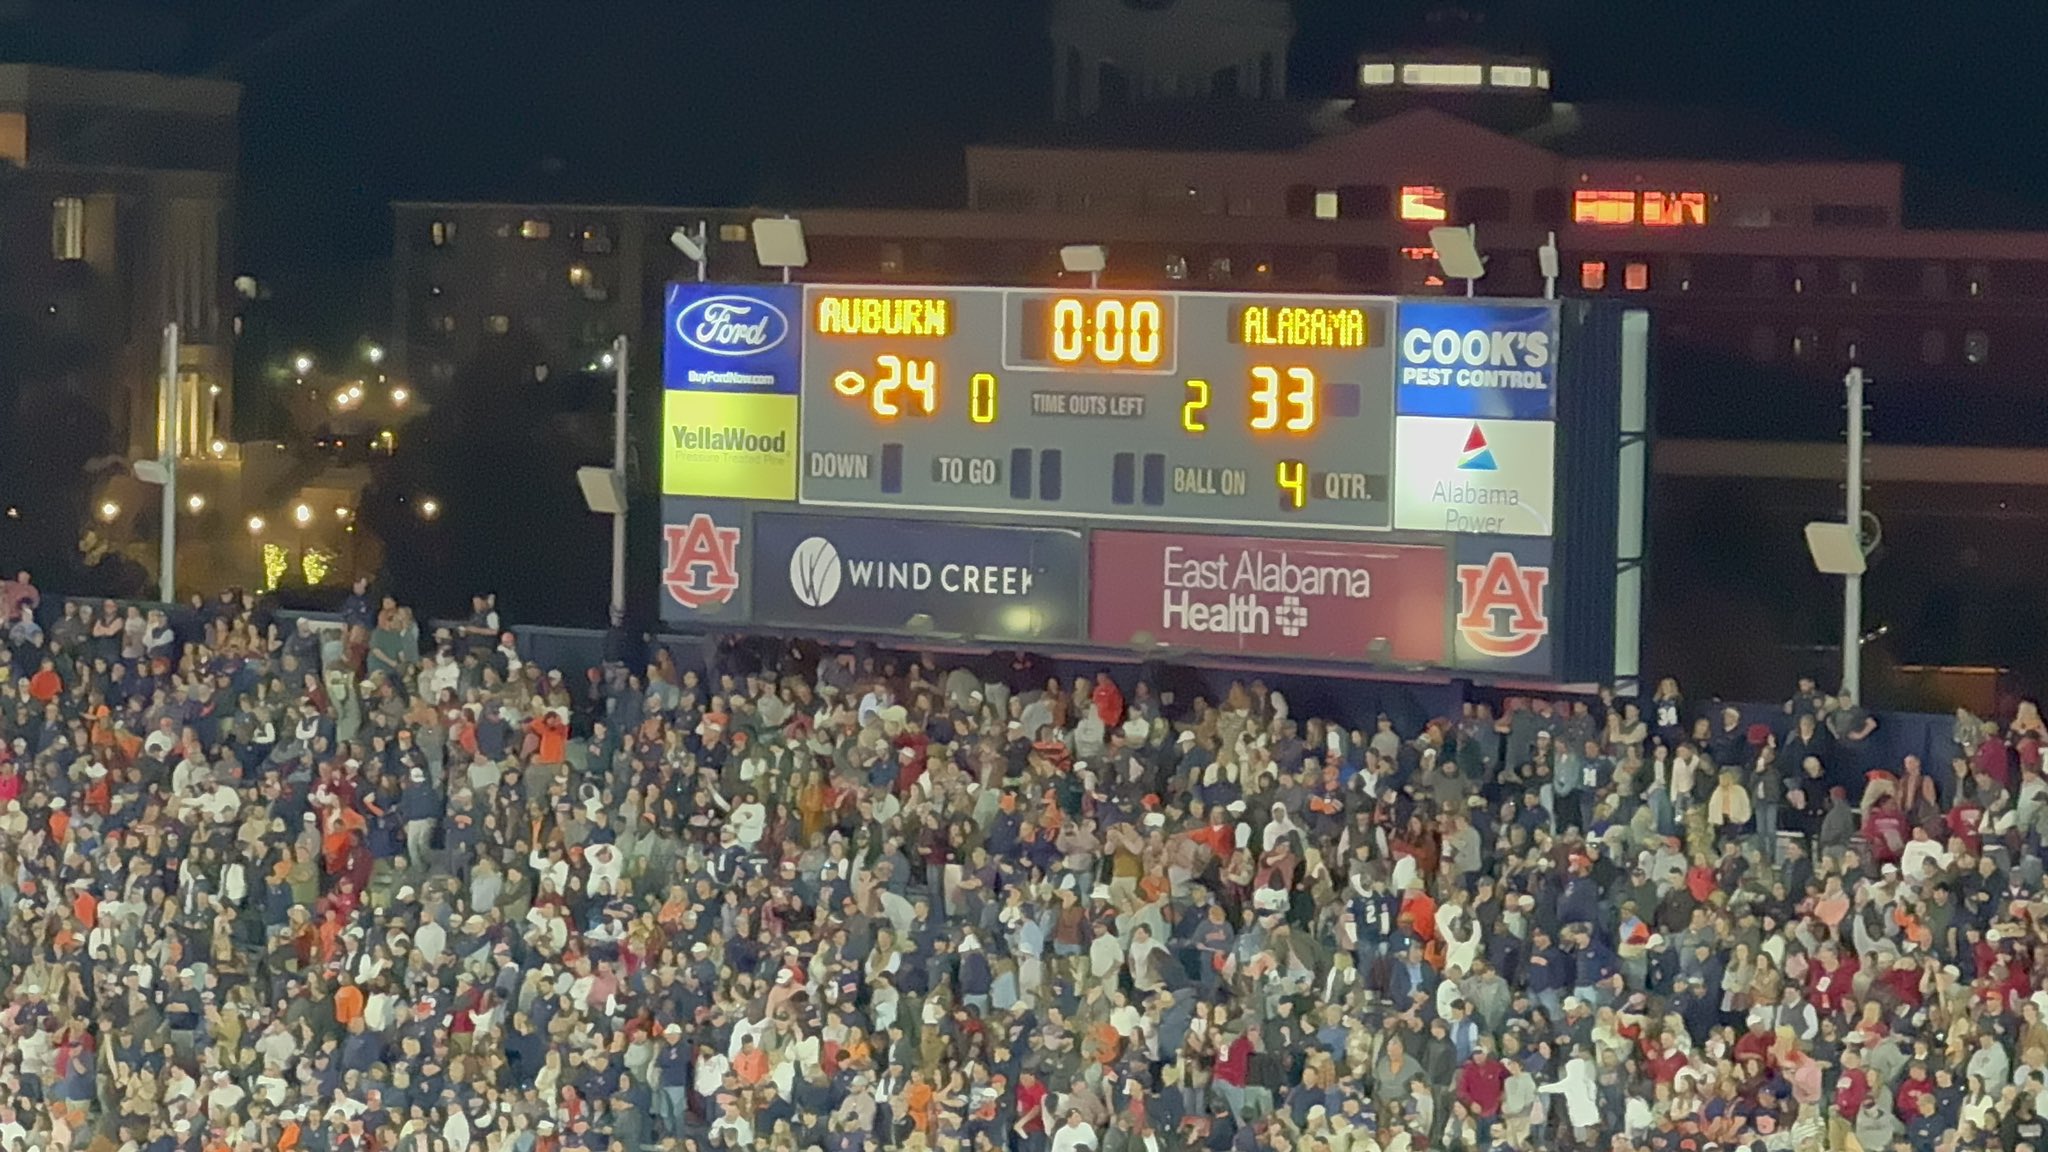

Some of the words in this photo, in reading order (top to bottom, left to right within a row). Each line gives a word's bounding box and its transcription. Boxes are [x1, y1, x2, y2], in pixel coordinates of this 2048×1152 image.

[695, 302, 769, 345] Ford
[820, 297, 946, 335] AUBURN
[1054, 299, 1160, 363] 0:00
[1244, 306, 1365, 346] ALABAMA
[1403, 327, 1549, 368] COOK'S
[873, 355, 934, 416] 24
[1403, 367, 1452, 386] PEST
[1456, 369, 1547, 389] CONTROL
[971, 373, 993, 423] 0
[1033, 393, 1065, 412] TIME
[1069, 396, 1106, 415] OUTS
[1110, 397, 1144, 416] LEFT
[1183, 380, 1208, 431] 2
[1250, 366, 1315, 430] 33
[672, 425, 785, 453] YellaWood
[811, 453, 868, 478] DOWN
[938, 457, 963, 483] TO
[969, 459, 995, 484] GO
[1174, 467, 1216, 494] BALL
[1221, 469, 1245, 495] ON
[1278, 461, 1303, 507] 4
[1325, 472, 1372, 500] QTR.
[1432, 480, 1519, 506] Alabama
[1444, 508, 1504, 533] Power
[848, 559, 931, 591] WIND
[1163, 546, 1227, 590] East
[1232, 550, 1370, 599] Alabama
[1162, 588, 1270, 634] Health
